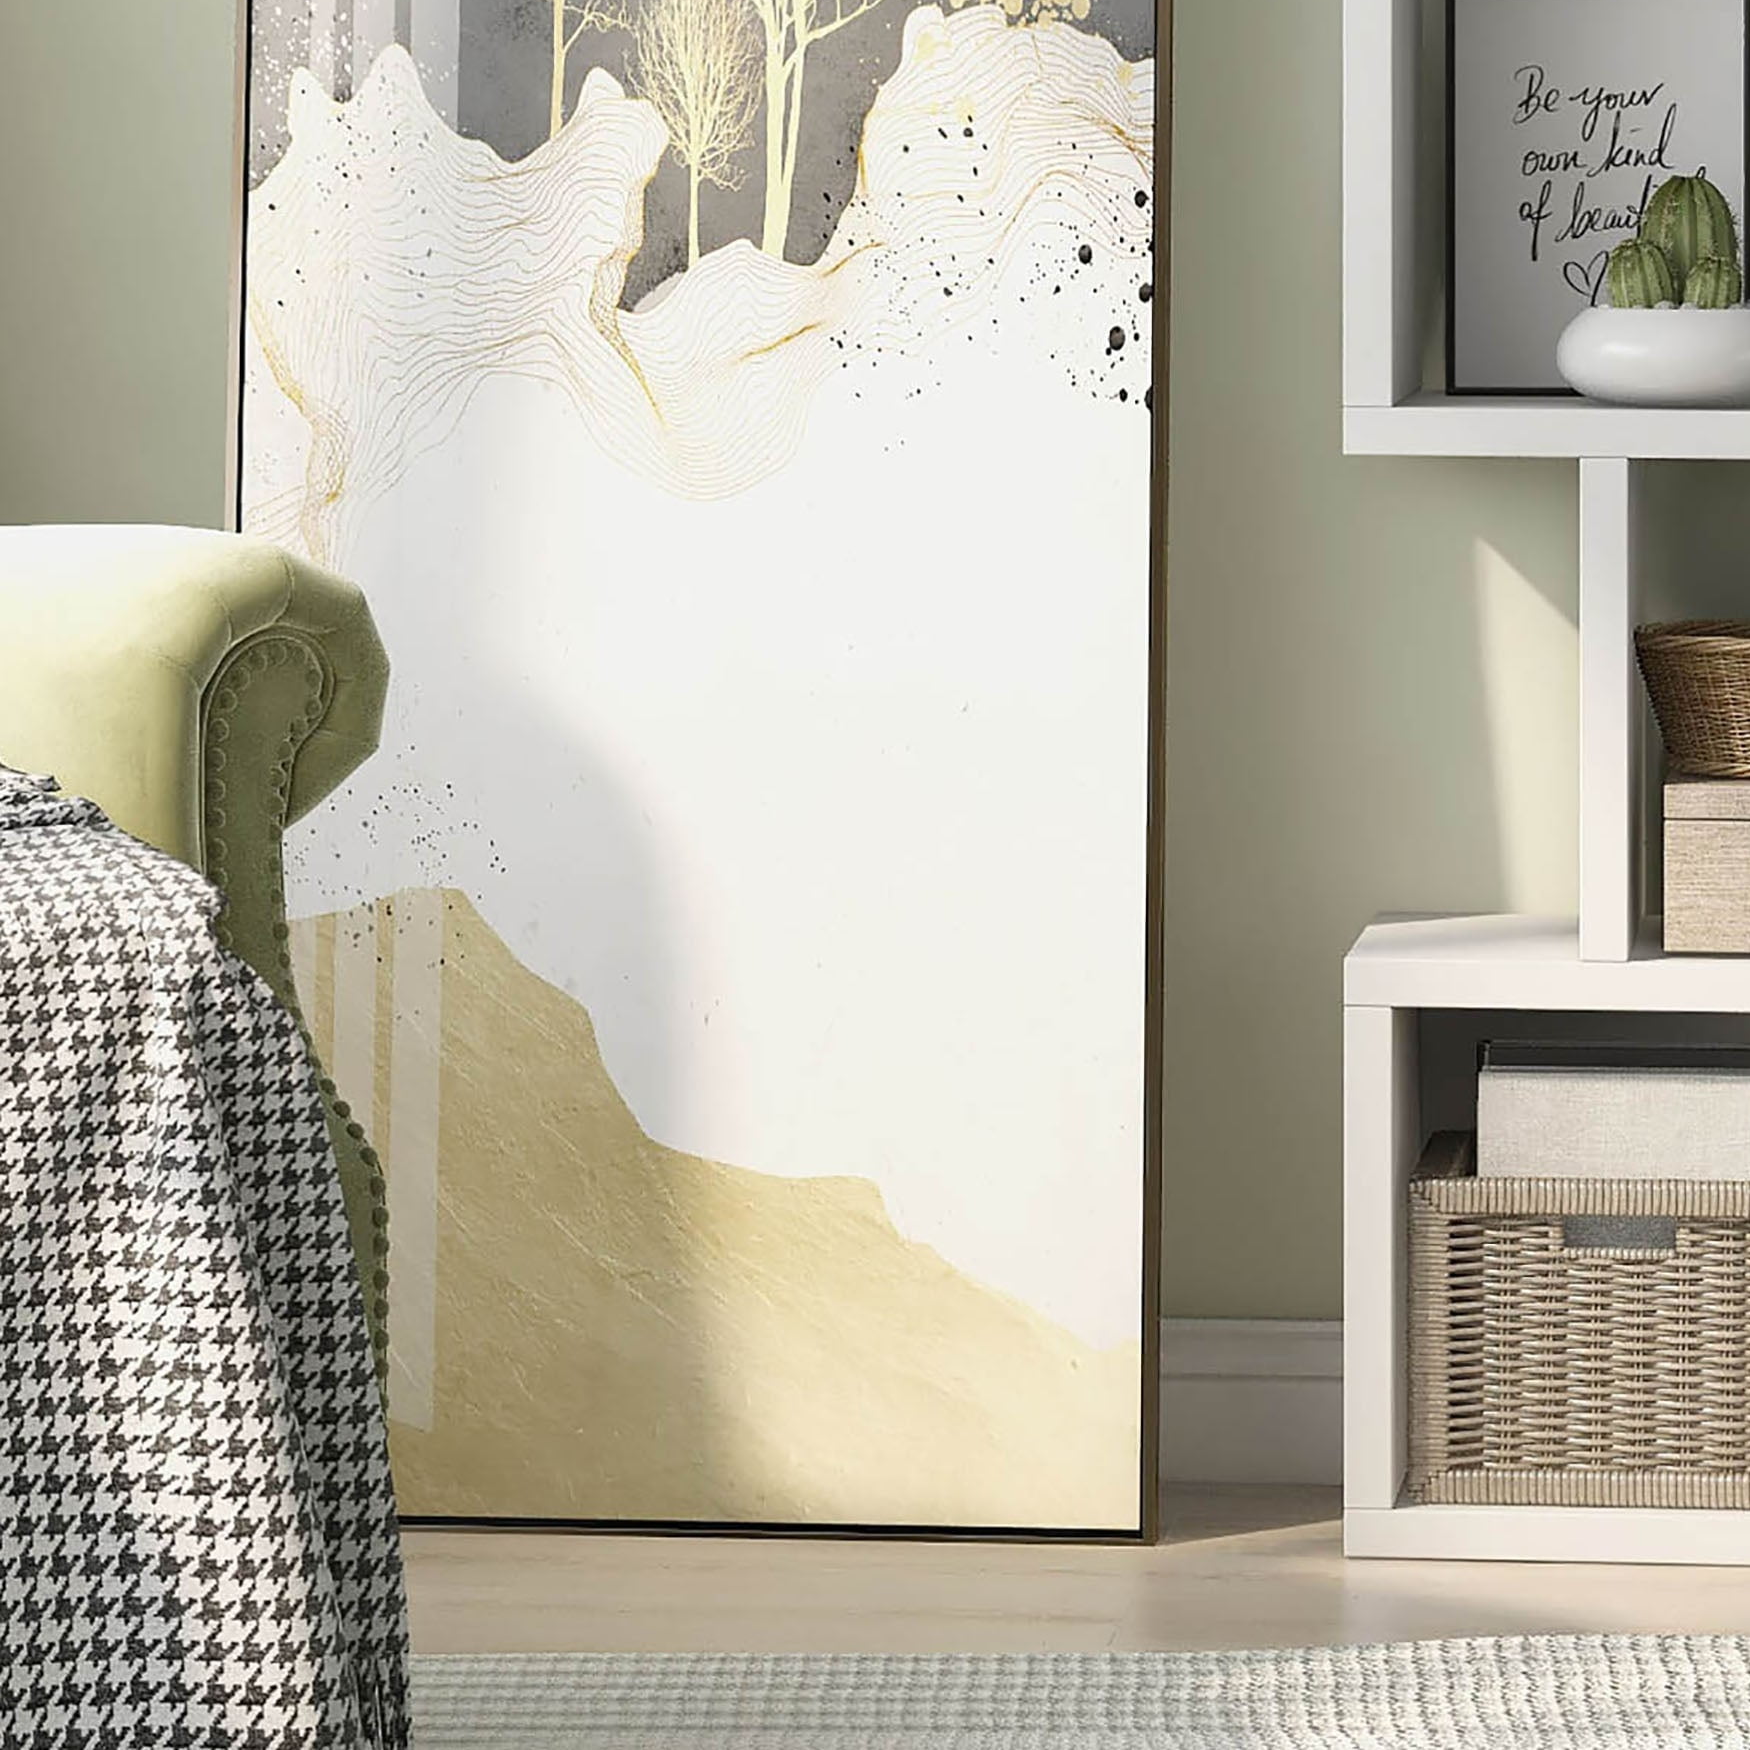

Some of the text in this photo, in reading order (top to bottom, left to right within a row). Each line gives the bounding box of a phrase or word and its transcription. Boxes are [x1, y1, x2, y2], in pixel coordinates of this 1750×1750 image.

[1513, 65, 1665, 143] Be your
[1521, 103, 1678, 178] own kind
[1519, 180, 1554, 262] of
